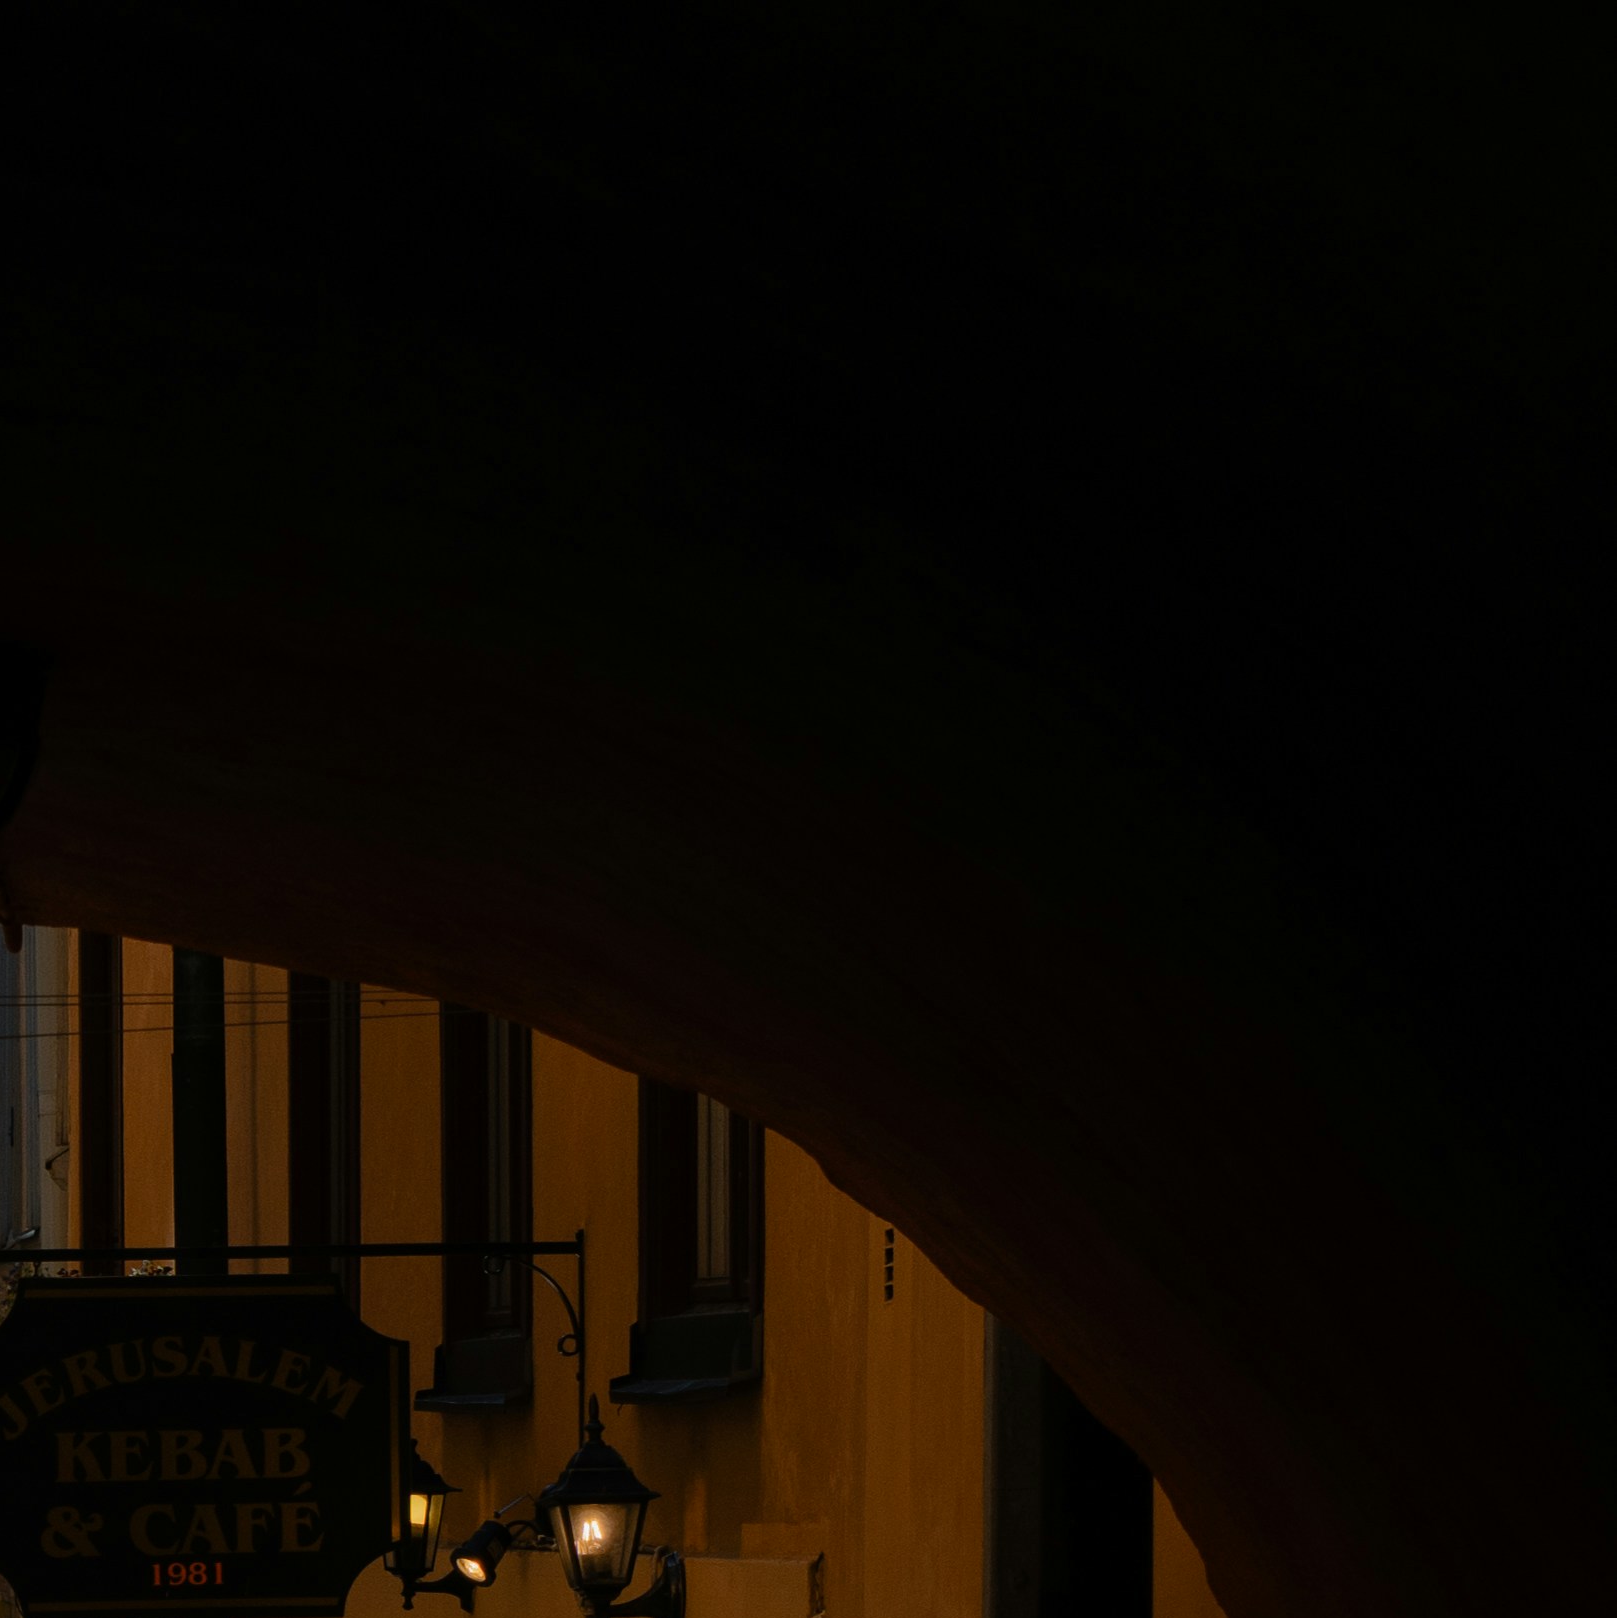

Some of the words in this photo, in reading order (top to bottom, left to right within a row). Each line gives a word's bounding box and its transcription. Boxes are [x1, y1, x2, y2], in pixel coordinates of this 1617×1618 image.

[55, 1427, 312, 1483] KEBAB
[41, 1505, 104, 1560] &
[129, 1482, 326, 1558] CAFÉ
[152, 1561, 224, 1587] 1981
